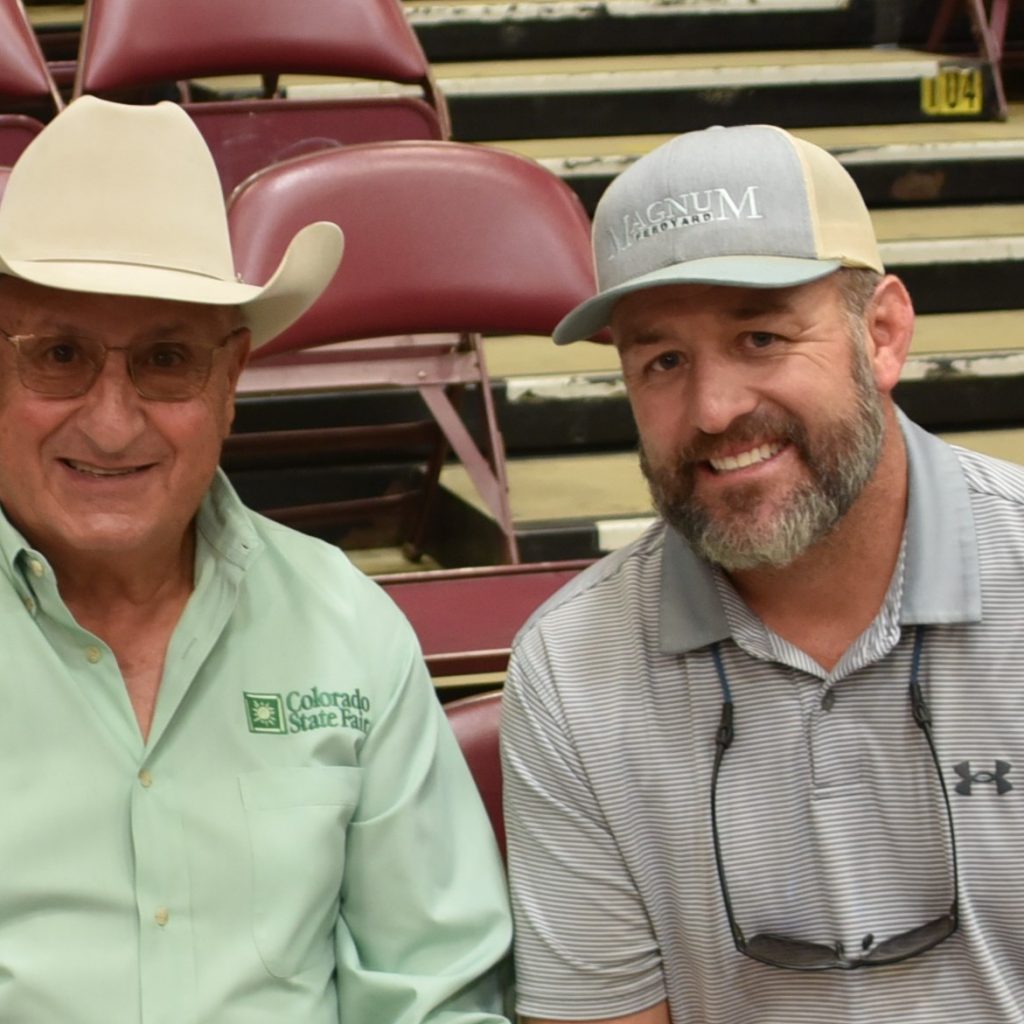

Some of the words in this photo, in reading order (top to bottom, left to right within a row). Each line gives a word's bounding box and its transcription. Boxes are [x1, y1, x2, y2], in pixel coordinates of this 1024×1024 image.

[928, 69, 975, 108] 104
[608, 186, 763, 261] MAGNUM
[635, 212, 713, 241] FEEDYARD
[286, 686, 371, 713] Colorado
[288, 710, 339, 734] State
[340, 706, 372, 735] Fair
